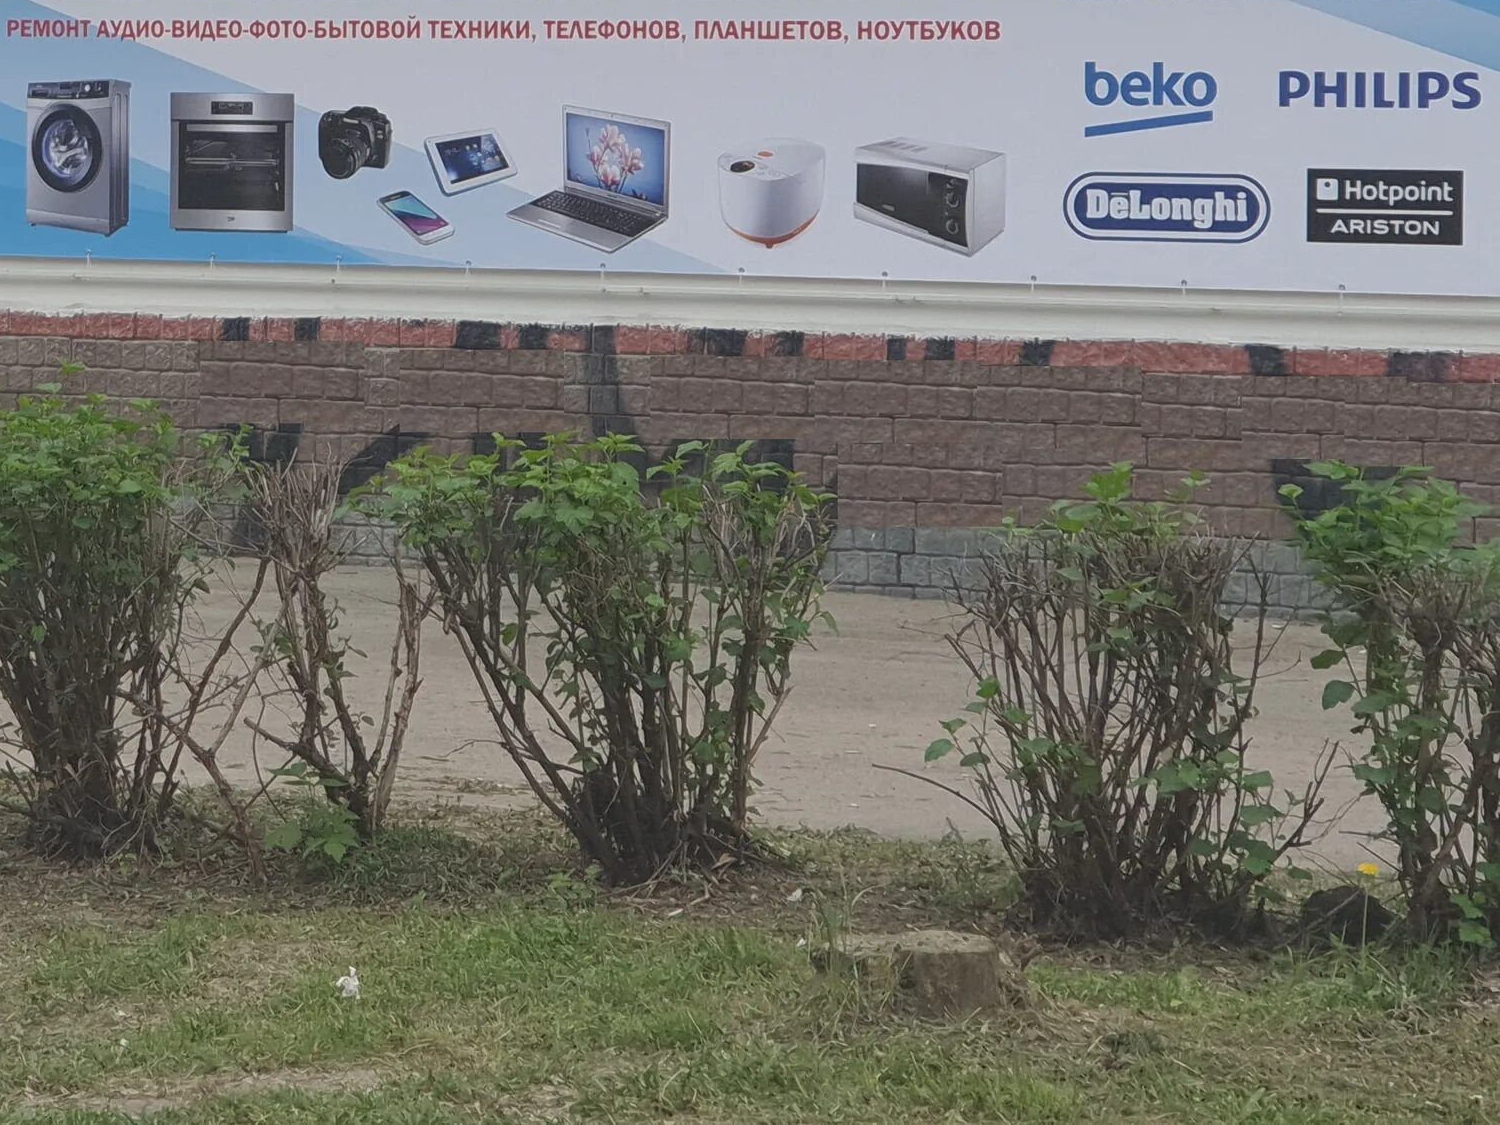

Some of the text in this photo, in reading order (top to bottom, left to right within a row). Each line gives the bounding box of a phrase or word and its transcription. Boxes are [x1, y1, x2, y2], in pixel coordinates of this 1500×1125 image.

[6, 15, 1001, 42] РЕМОНТ АУДИО-ВИДЕО-ФОТО-БЫТОВОЙ ТЕХНИКИ, ТЕЛЕФОНОВ, ПЛАНШЕТОВ, НОУТБУКОВ
[1084, 61, 1218, 107] beko
[1278, 71, 1482, 109] PHILIPS
[1345, 180, 1454, 206] Hotpoint
[1330, 219, 1440, 236] ARISTON
